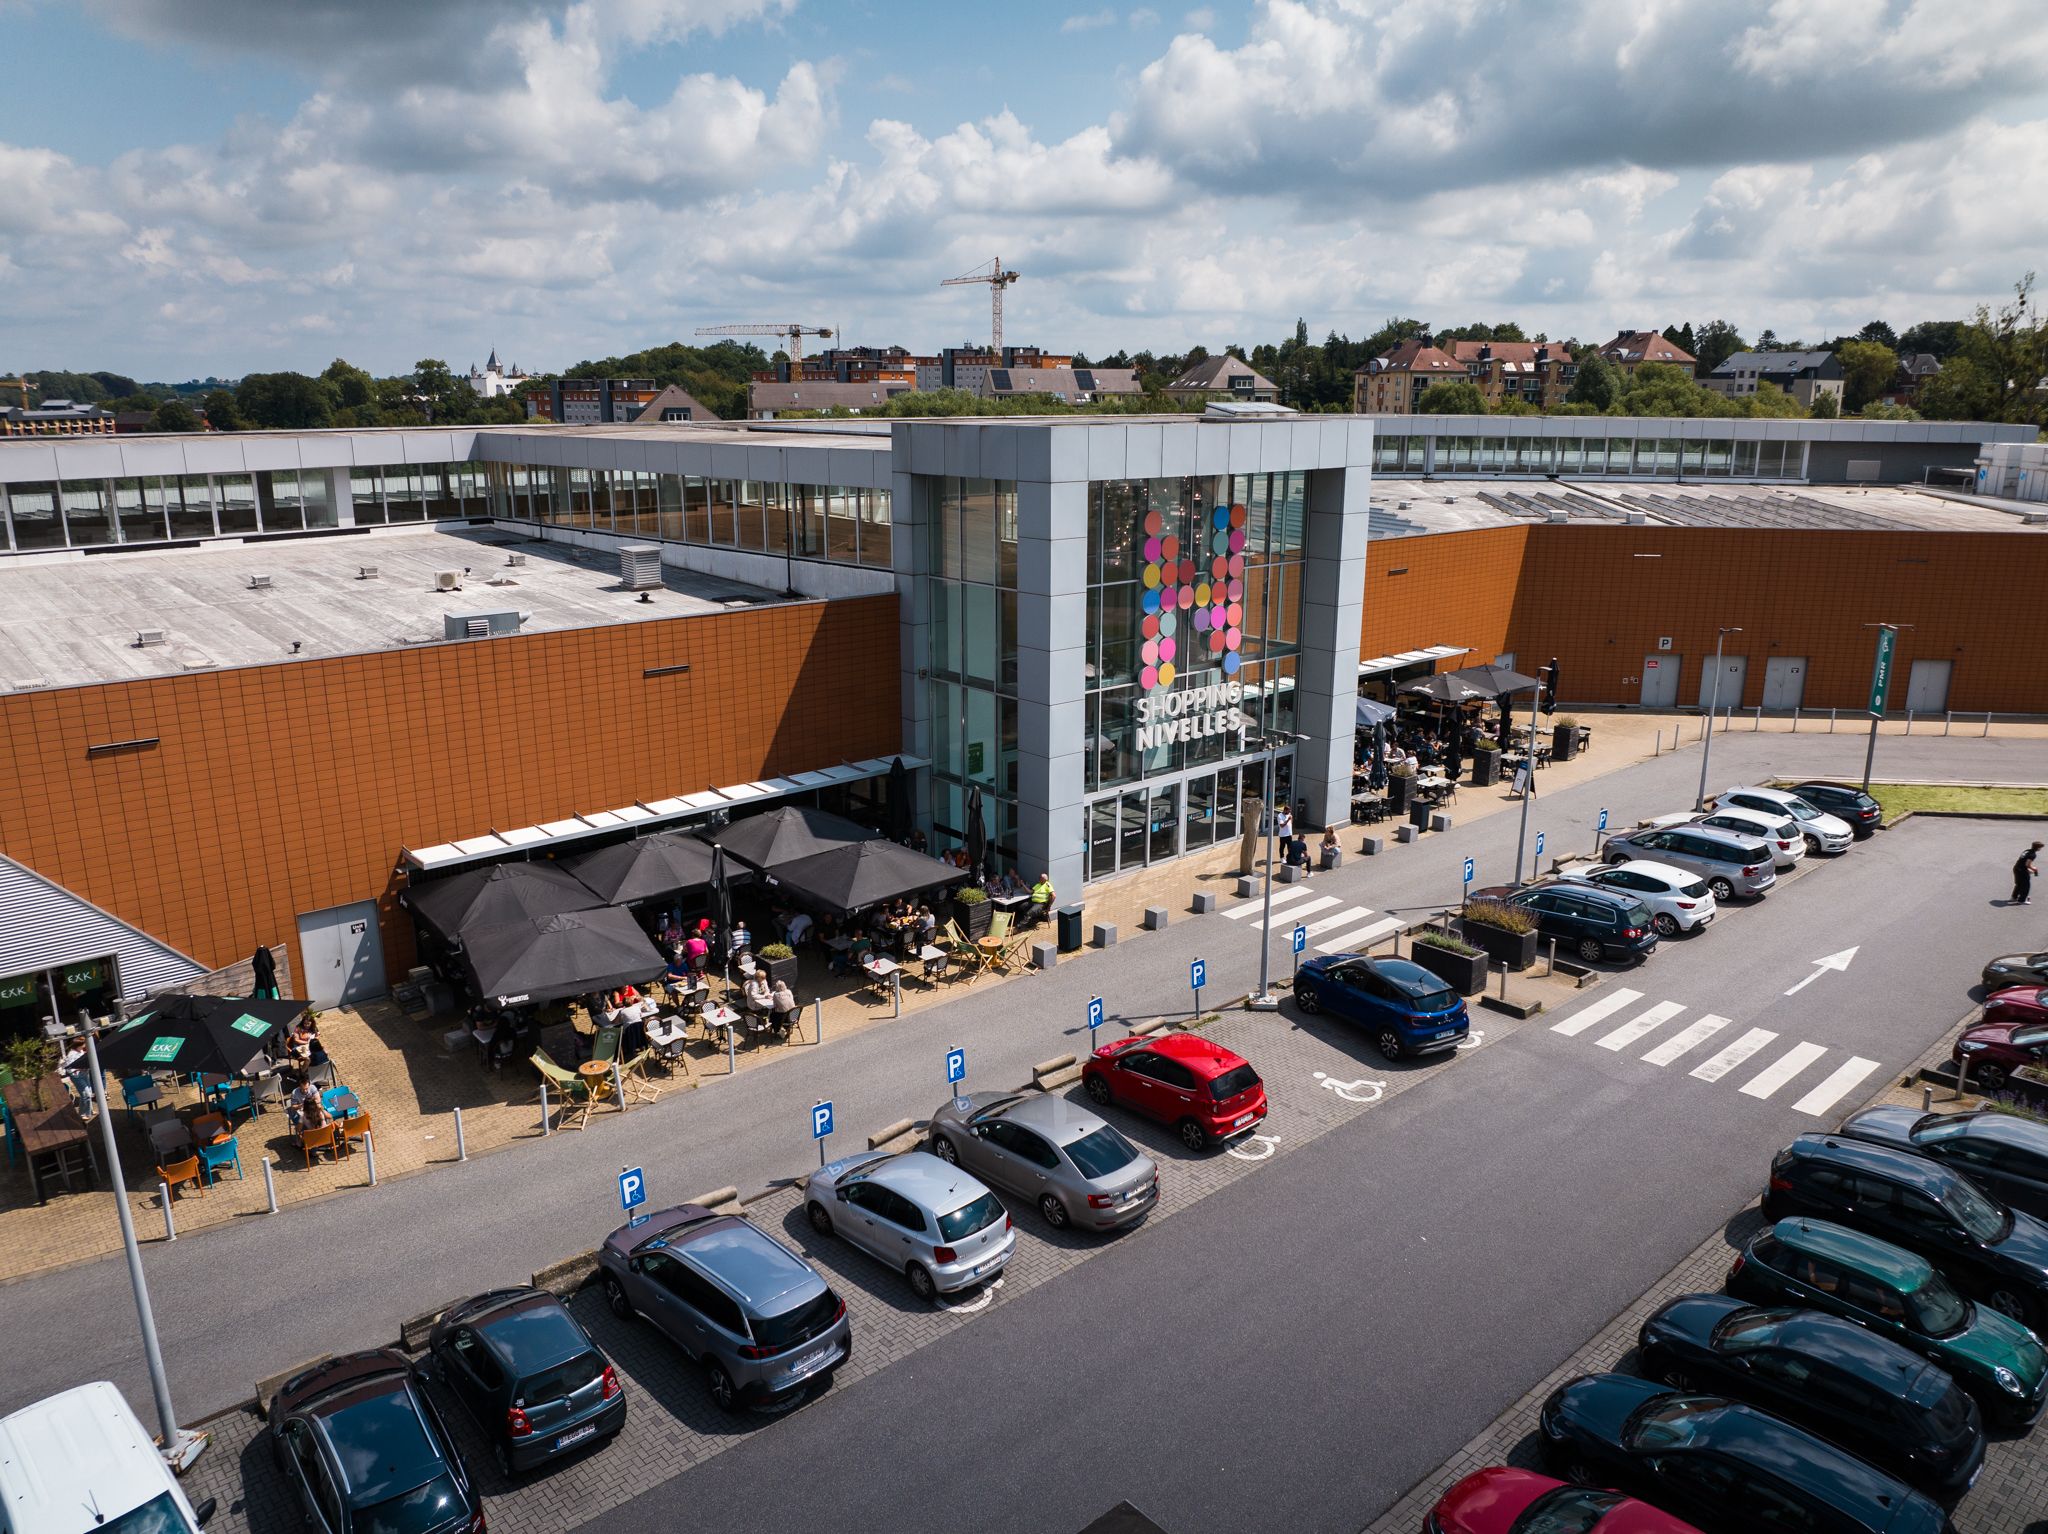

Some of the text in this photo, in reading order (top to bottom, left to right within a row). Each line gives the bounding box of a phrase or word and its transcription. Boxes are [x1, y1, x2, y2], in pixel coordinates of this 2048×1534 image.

[1661, 639, 1669, 648] P
[1878, 661, 1886, 687] PMR
[1136, 681, 1241, 723] SHOPPING
[1136, 707, 1241, 751] NIVELLES
[1237, 724, 1246, 752] 1
[1600, 813, 1607, 829] P
[1537, 836, 1543, 852] P
[1465, 863, 1472, 880] P
[1295, 931, 1304, 950] P
[1193, 965, 1203, 985] P
[1090, 1003, 1100, 1026] P
[949, 1054, 962, 1079] P
[815, 1108, 830, 1134] P
[622, 1175, 640, 1204] P
